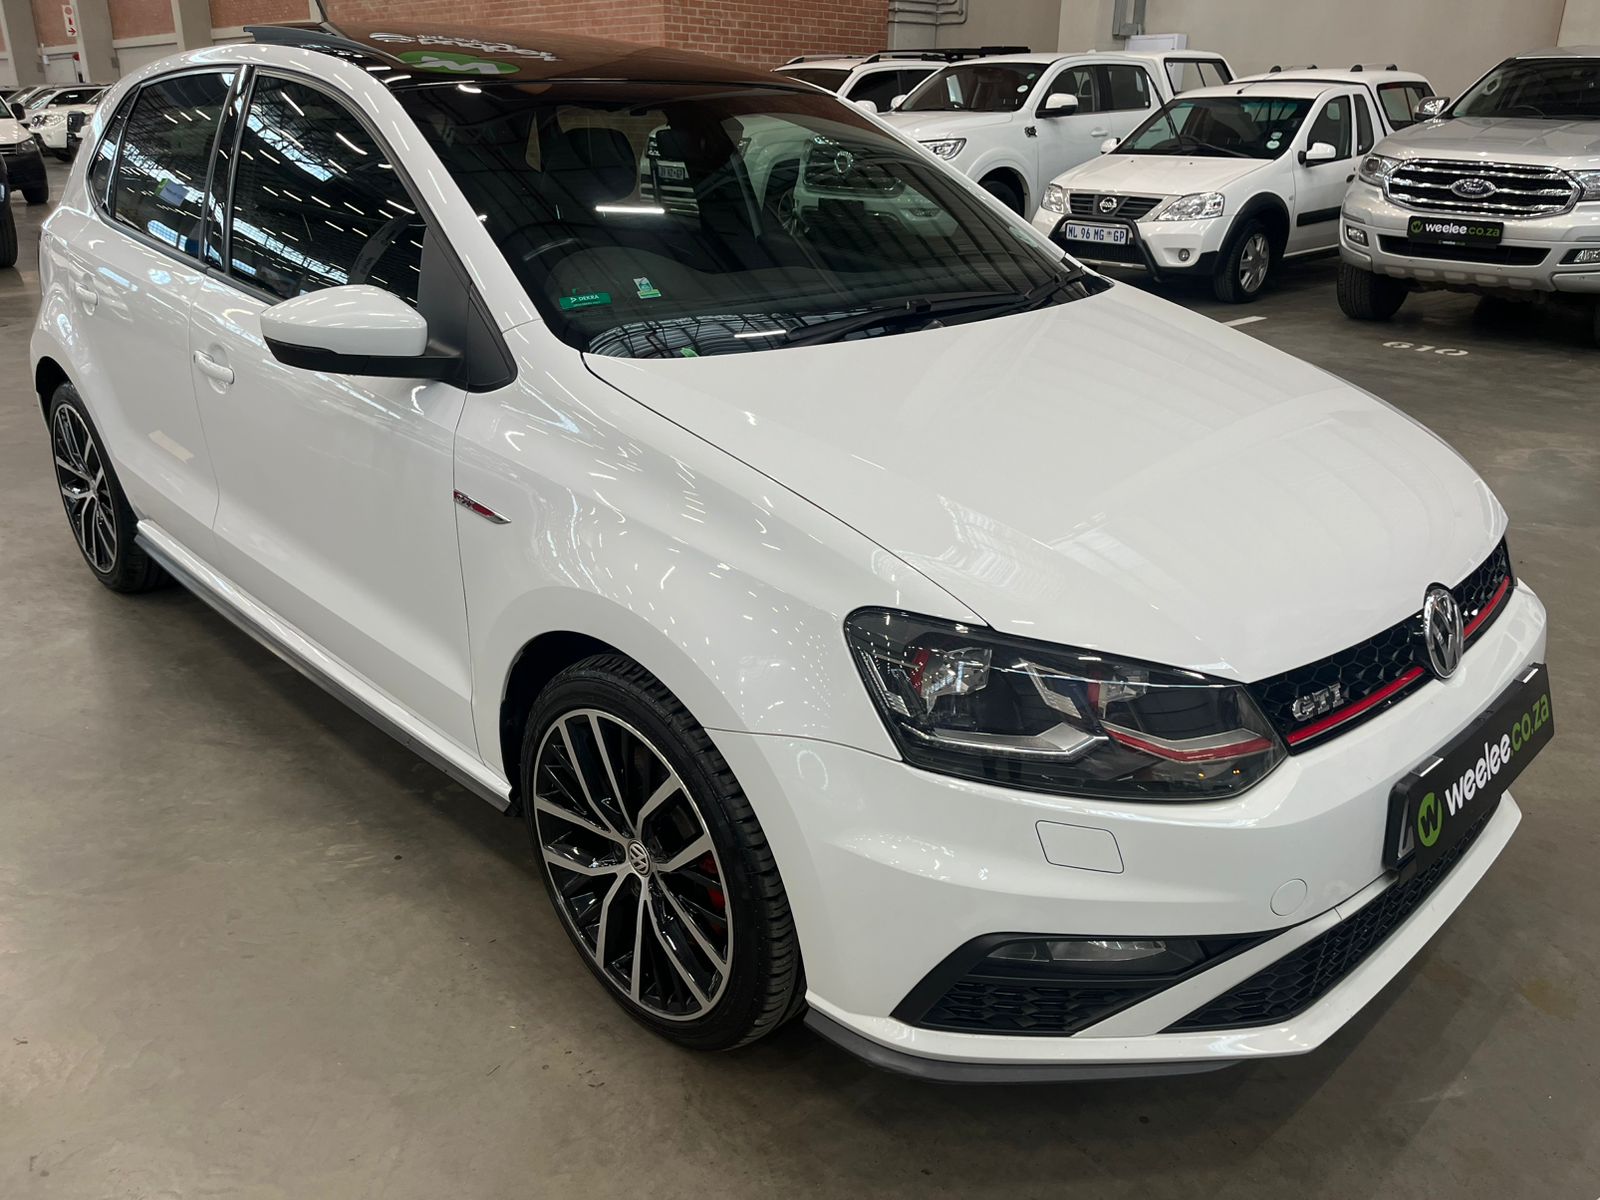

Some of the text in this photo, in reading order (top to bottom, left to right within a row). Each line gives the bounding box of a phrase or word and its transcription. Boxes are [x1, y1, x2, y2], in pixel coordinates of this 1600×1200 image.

[1068, 226, 1125, 242] NL 96 MG GP
[1425, 223, 1500, 237] weelee.co.za
[578, 294, 600, 302] DEKRA
[1382, 341, 1469, 356] 610
[1292, 683, 1345, 721] GTI
[1444, 693, 1550, 817] weelee.co.za
